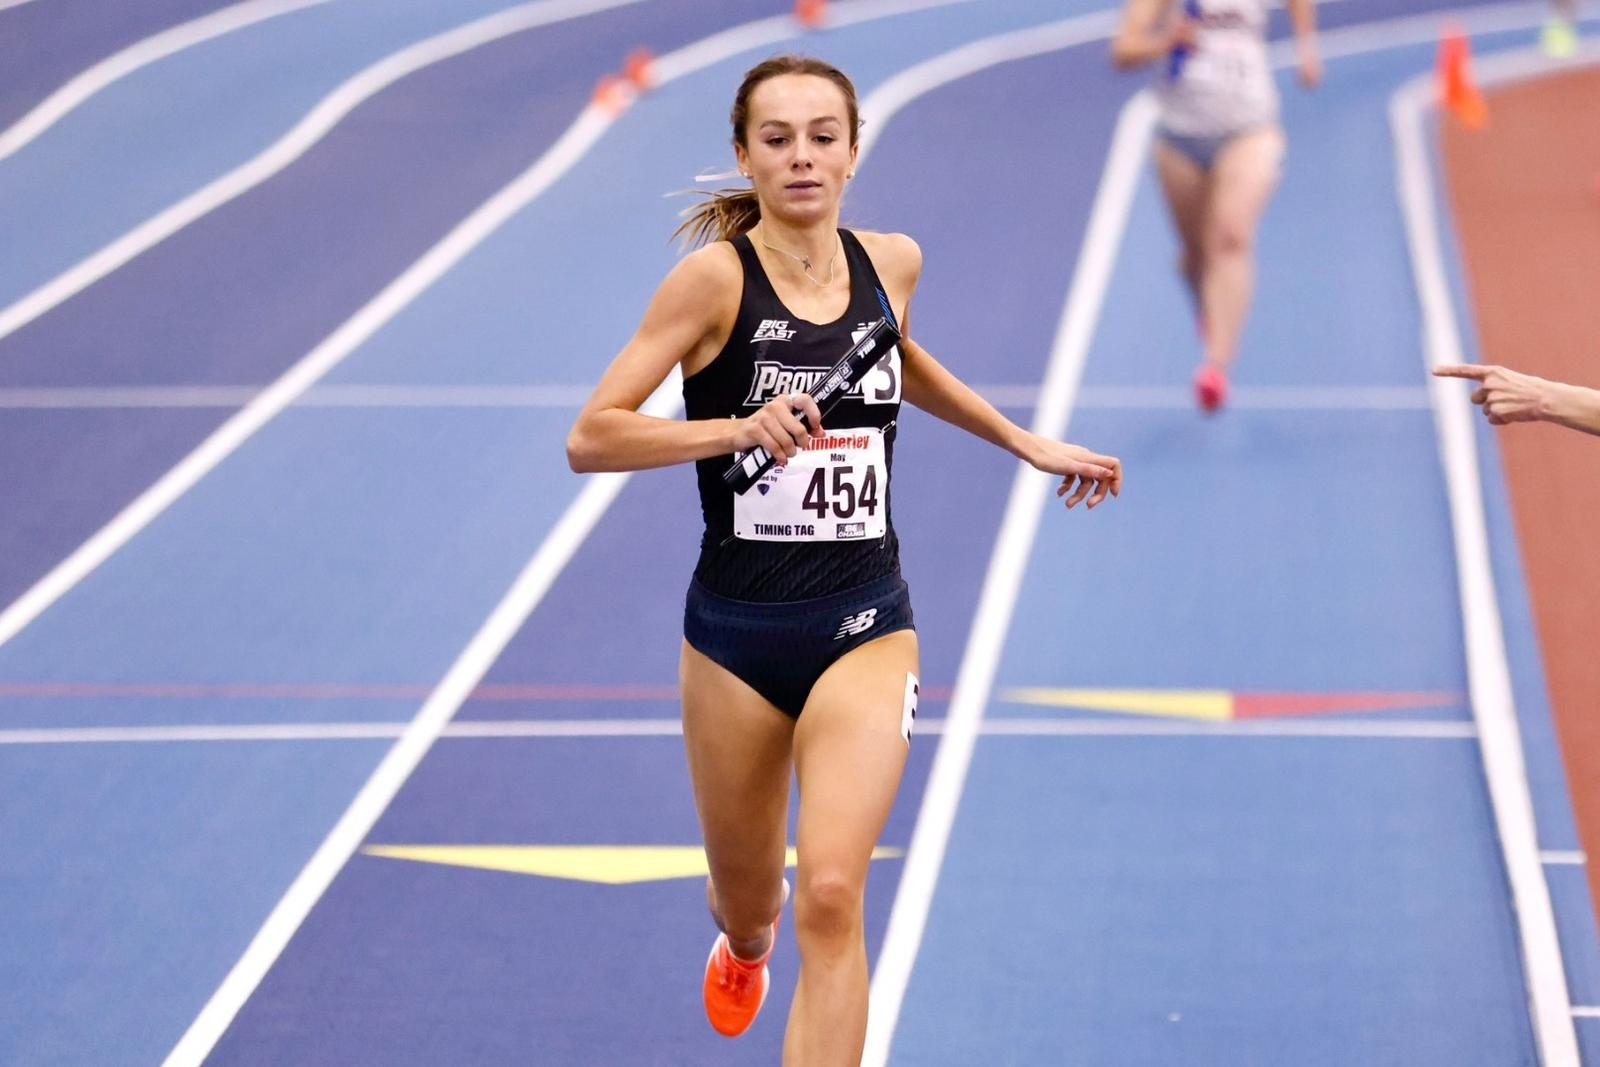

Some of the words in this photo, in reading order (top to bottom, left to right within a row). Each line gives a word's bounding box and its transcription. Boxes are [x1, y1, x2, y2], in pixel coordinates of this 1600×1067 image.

[758, 319, 789, 330] BIG
[753, 329, 797, 339] EAST
[874, 346, 897, 400] 3
[830, 453, 846, 463] May
[802, 465, 878, 519] 454
[754, 523, 792, 536] TIMING
[794, 524, 815, 536] TAG
